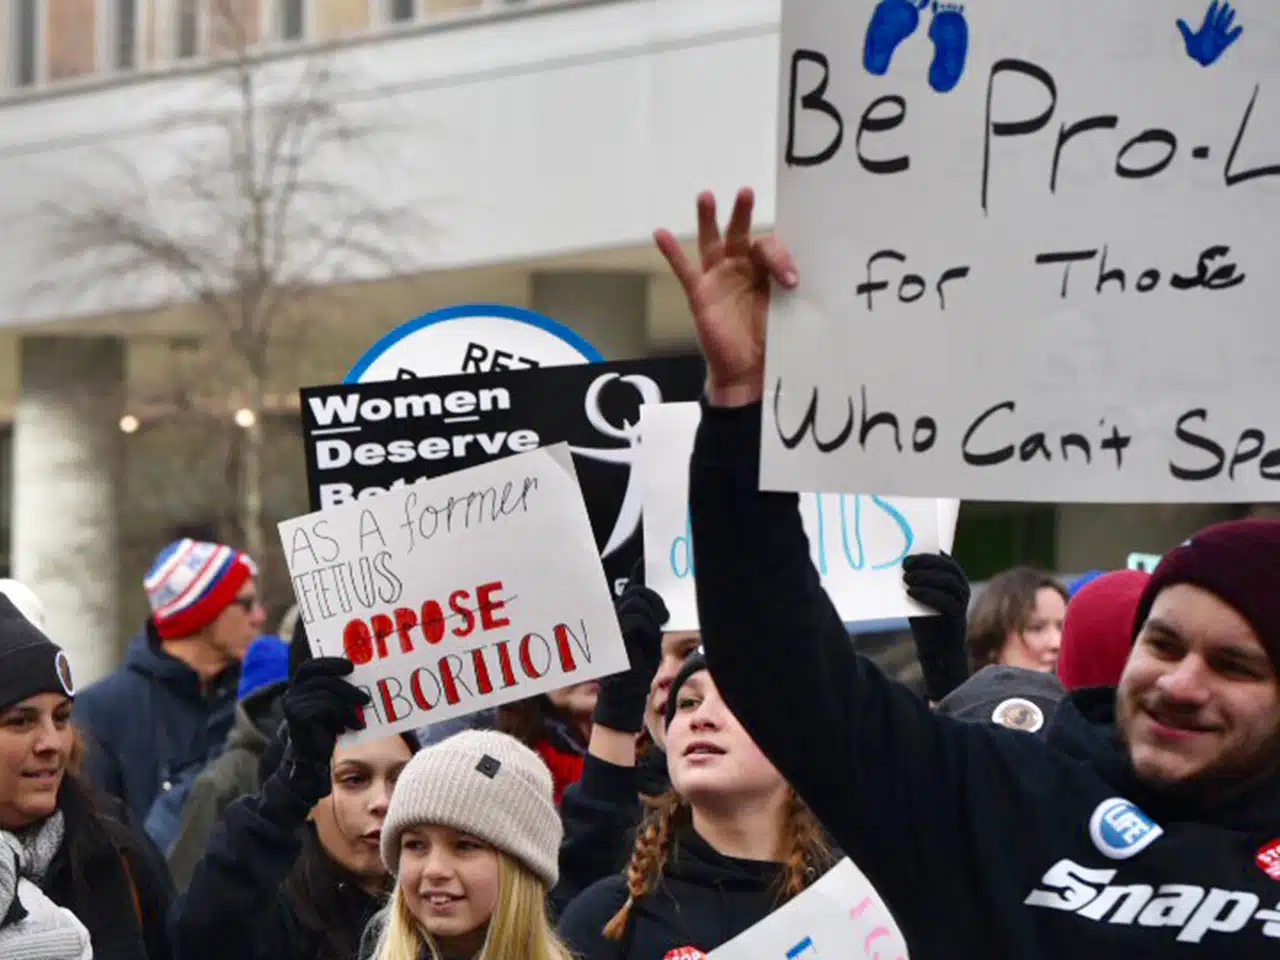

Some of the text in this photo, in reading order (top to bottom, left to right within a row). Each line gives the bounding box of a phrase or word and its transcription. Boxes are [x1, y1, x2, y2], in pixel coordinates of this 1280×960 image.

[784, 48, 910, 175] Be
[1035, 243, 1246, 299] Those
[308, 386, 511, 430] Women
[774, 377, 937, 454] Who
[962, 401, 1132, 470] Can't
[315, 429, 540, 471] Deserve
[293, 550, 403, 625] FETUS
[342, 581, 511, 666] OPPOSE
